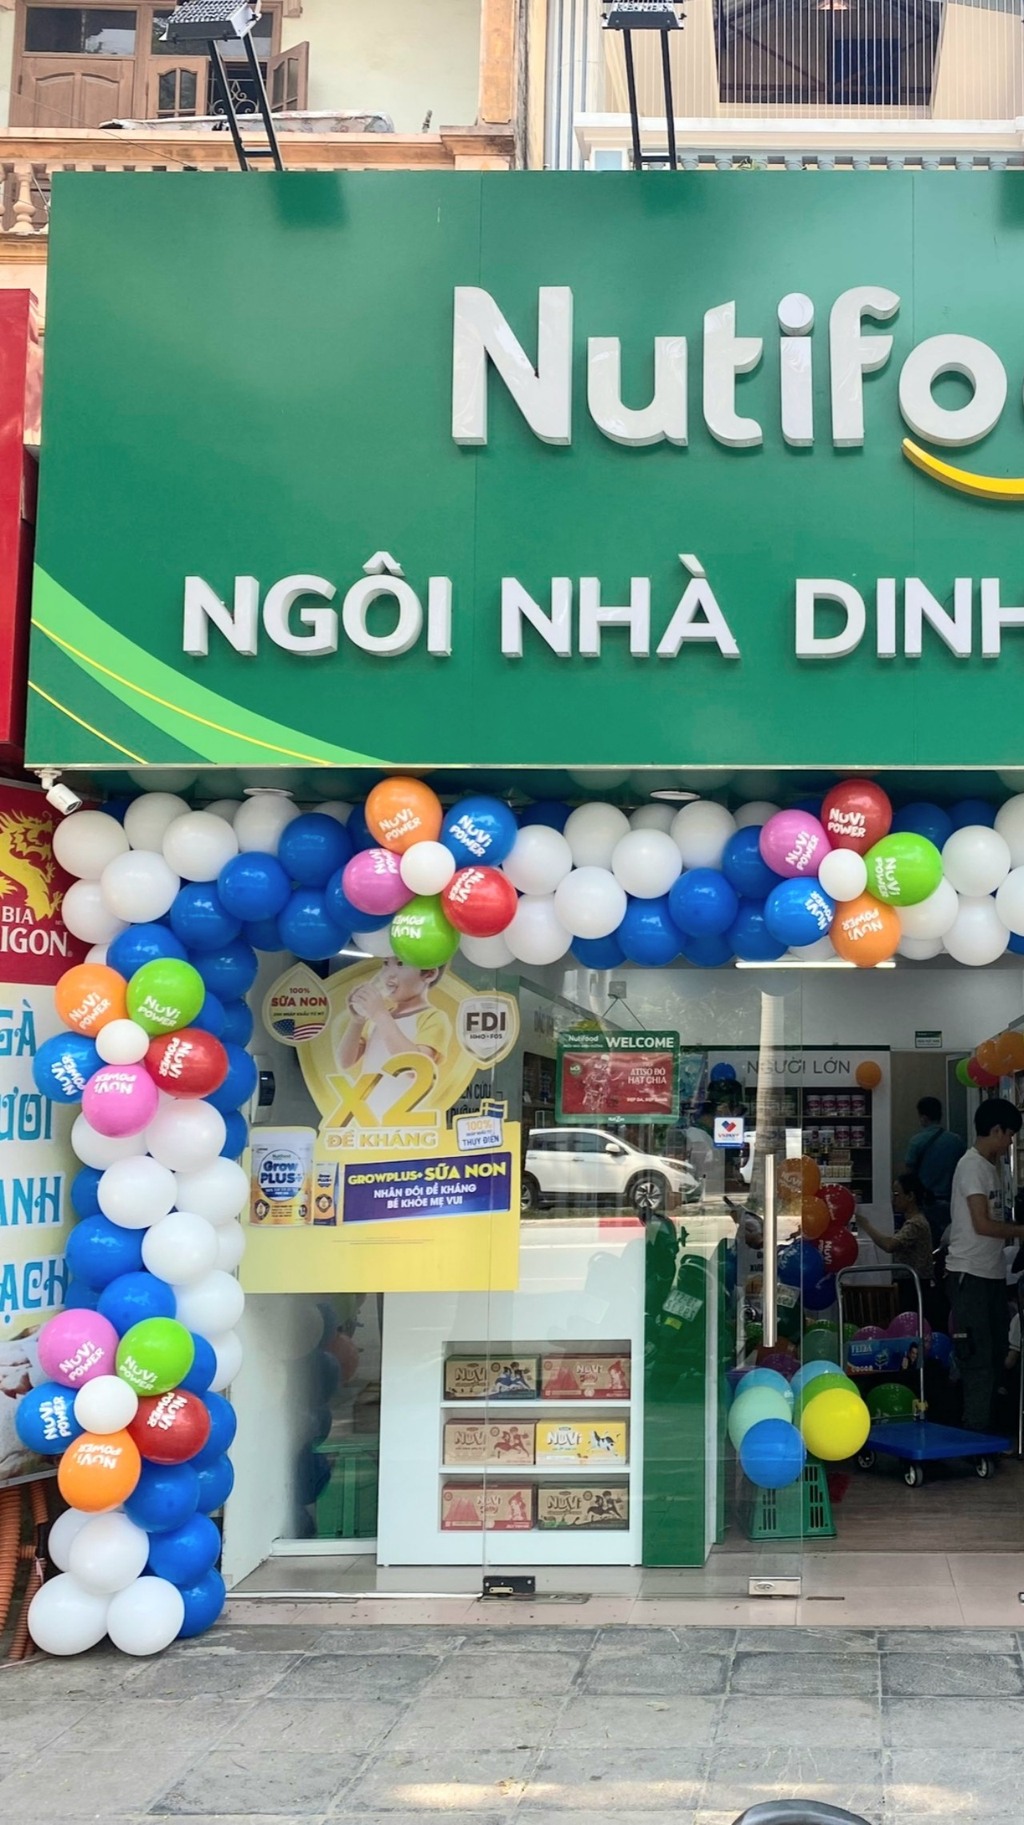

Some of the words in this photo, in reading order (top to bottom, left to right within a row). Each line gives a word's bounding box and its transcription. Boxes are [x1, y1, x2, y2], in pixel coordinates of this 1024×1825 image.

[183, 551, 452, 657] NGÔI
[500, 554, 740, 658] NHÀ
[384, 817, 422, 841] POWER
[827, 822, 866, 838] POWER
[449, 825, 486, 857] POWER
[796, 835, 819, 871] POWER
[448, 868, 475, 901] POWER
[875, 856, 890, 898] POWER
[2, 906, 34, 925] BIA
[842, 908, 880, 930] POWER
[271, 995, 297, 1007] SỮA
[300, 996, 328, 1006] NON
[80, 998, 111, 1029] POWER
[137, 1007, 176, 1027] POWER
[467, 1012, 506, 1031] FDI
[606, 1037, 674, 1048] WELCOME
[159, 1037, 177, 1077] POWER
[813, 1057, 850, 1074] LỚN
[62, 1054, 85, 1090] POWER
[95, 1073, 136, 1084] POWER
[466, 1121, 493, 1131] 100%
[360, 1130, 437, 1148] KHÁNG
[263, 1161, 299, 1172] Grow
[424, 1163, 460, 1181] SỮA
[465, 1162, 507, 1178] NON
[441, 1183, 476, 1193] KHÁNG
[430, 1197, 445, 1208] MẸ
[447, 1196, 463, 1205] VUI
[68, 1347, 105, 1381] POWER
[119, 1366, 154, 1391] POWER
[53, 1396, 72, 1438] POWER
[147, 1392, 175, 1428] POWER
[77, 1443, 123, 1455] POWER
